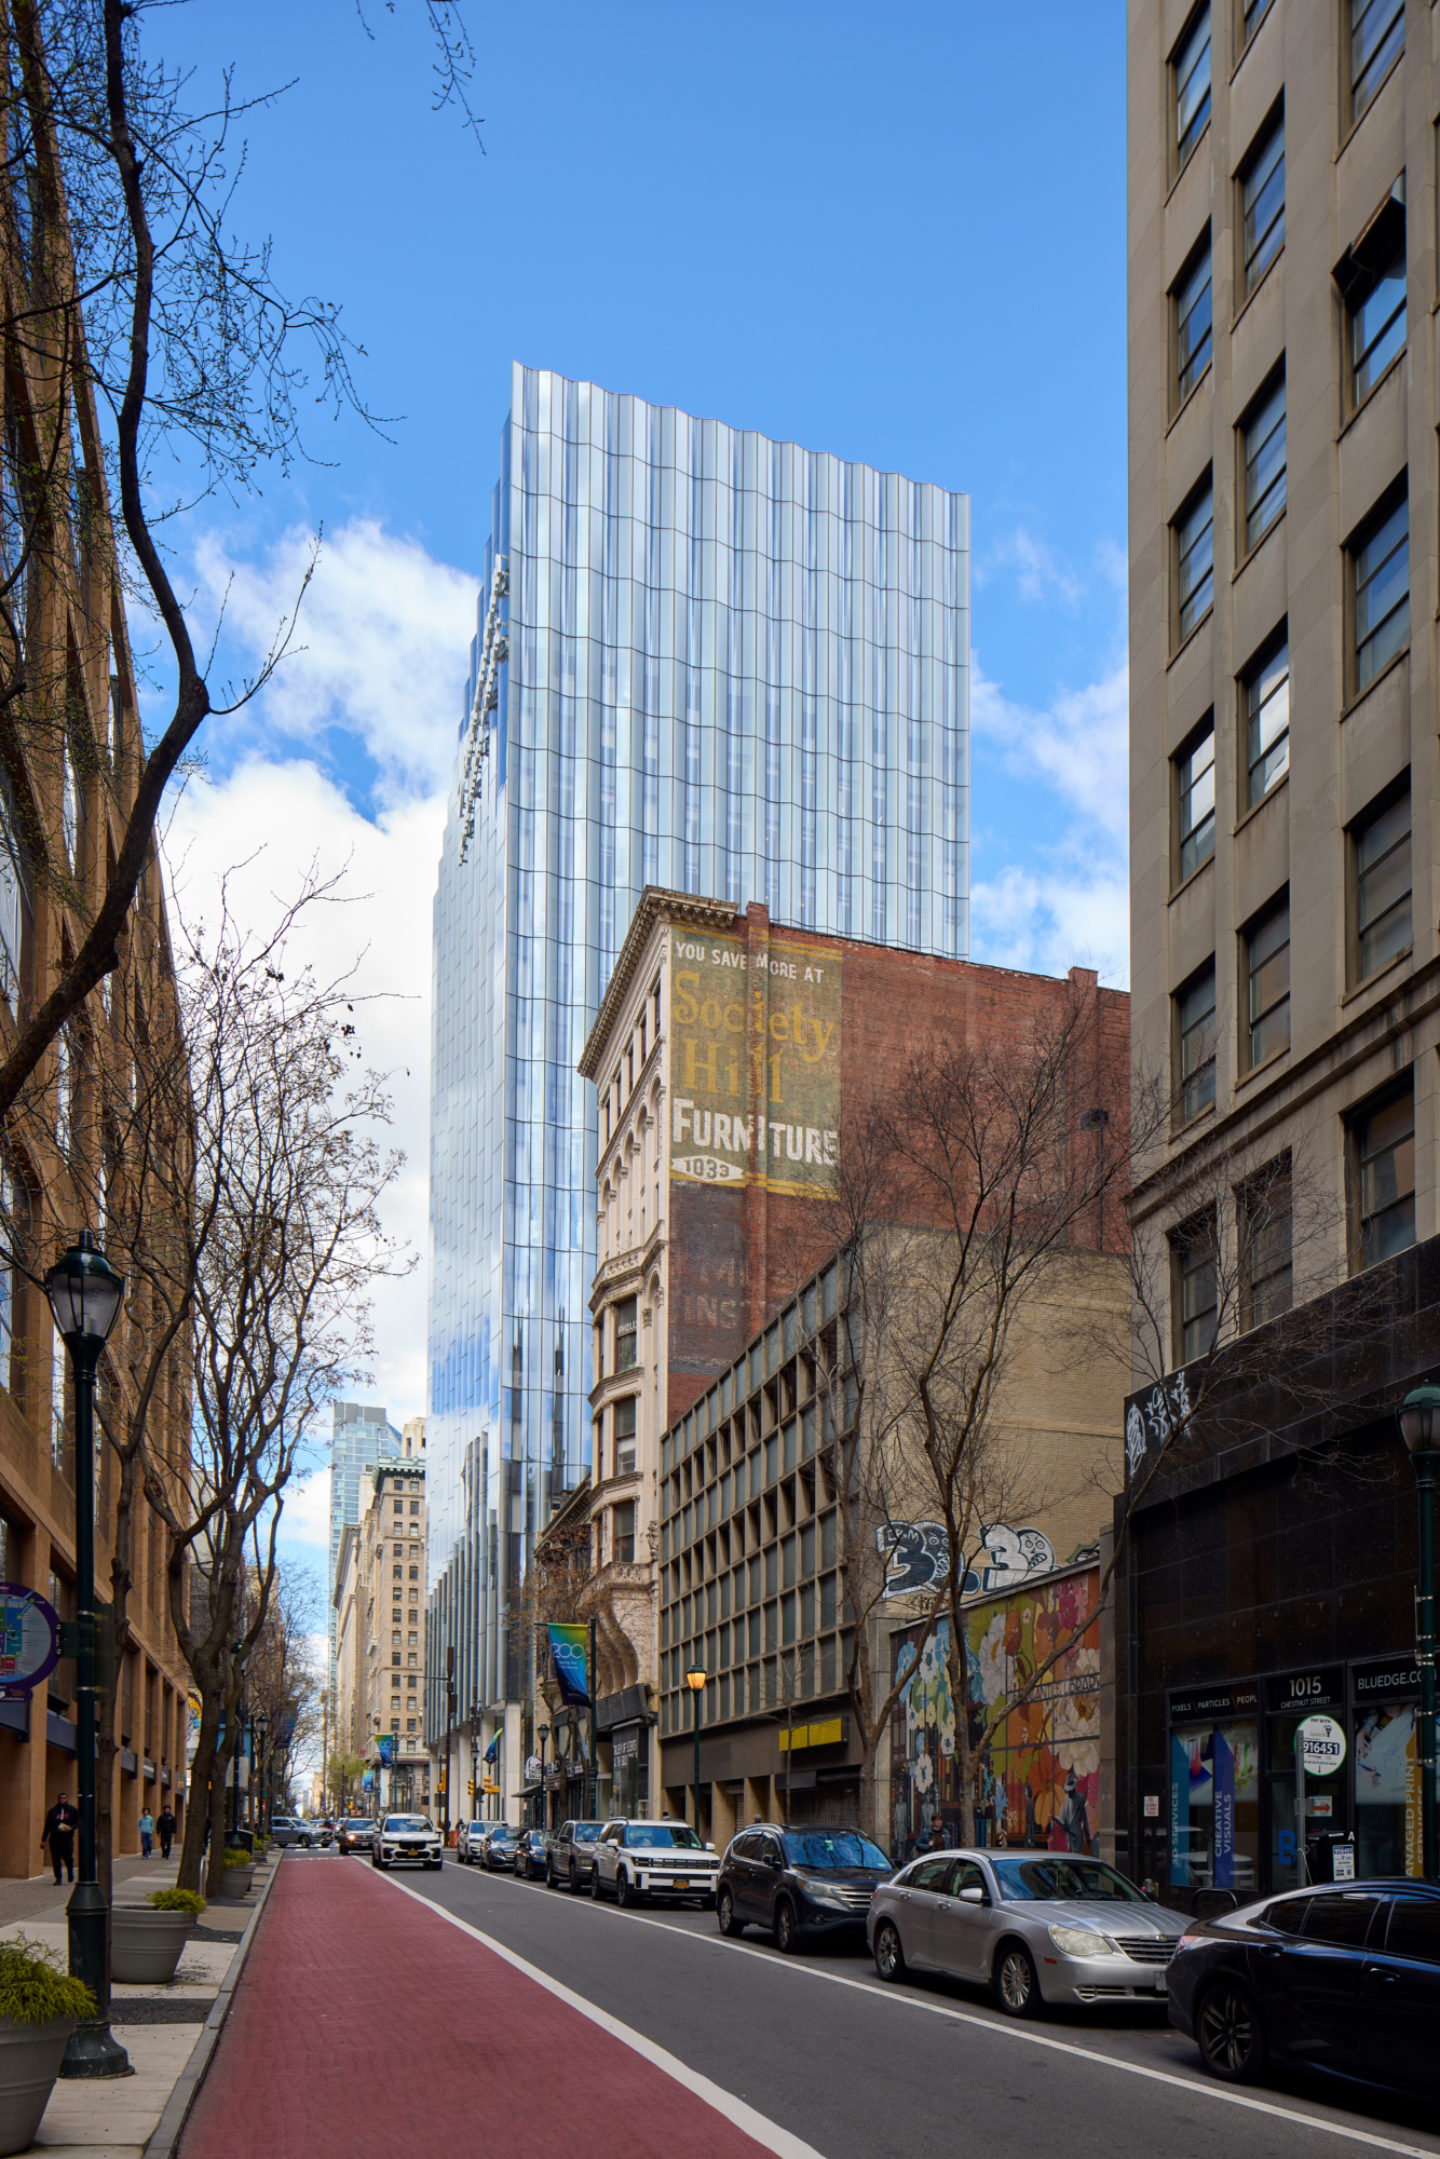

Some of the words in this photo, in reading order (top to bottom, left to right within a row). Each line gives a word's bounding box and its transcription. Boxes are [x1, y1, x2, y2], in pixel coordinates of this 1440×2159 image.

[676, 941, 705, 962] YOU
[711, 948, 747, 970] SAVE
[757, 952, 797, 979] MORE
[803, 966, 825, 984] AT
[673, 970, 835, 1063] Society
[682, 1037, 784, 1103] Hill
[683, 1157, 730, 1180] 1033
[551, 1643, 585, 1659] 200
[1289, 1675, 1323, 1697] 1015
[1358, 1669, 1437, 1690] BLUEDGE.CO
[1171, 1703, 1192, 1712] PIXELS
[1197, 1698, 1231, 1709] PARTICLES
[1236, 1695, 1257, 1705] PEOPL
[1280, 1698, 1309, 1709] CHESTNUT
[1310, 1696, 1331, 1705] STREET
[1303, 1741, 1339, 1754] 916451
[1405, 1756, 1415, 1804] PRINT
[1171, 1782, 1179, 1845] SERVICES
[1215, 1790, 1223, 1857] CREATIVE
[1223, 1793, 1232, 1854] VISUALS
[1405, 1808, 1415, 1877] ANAGED
